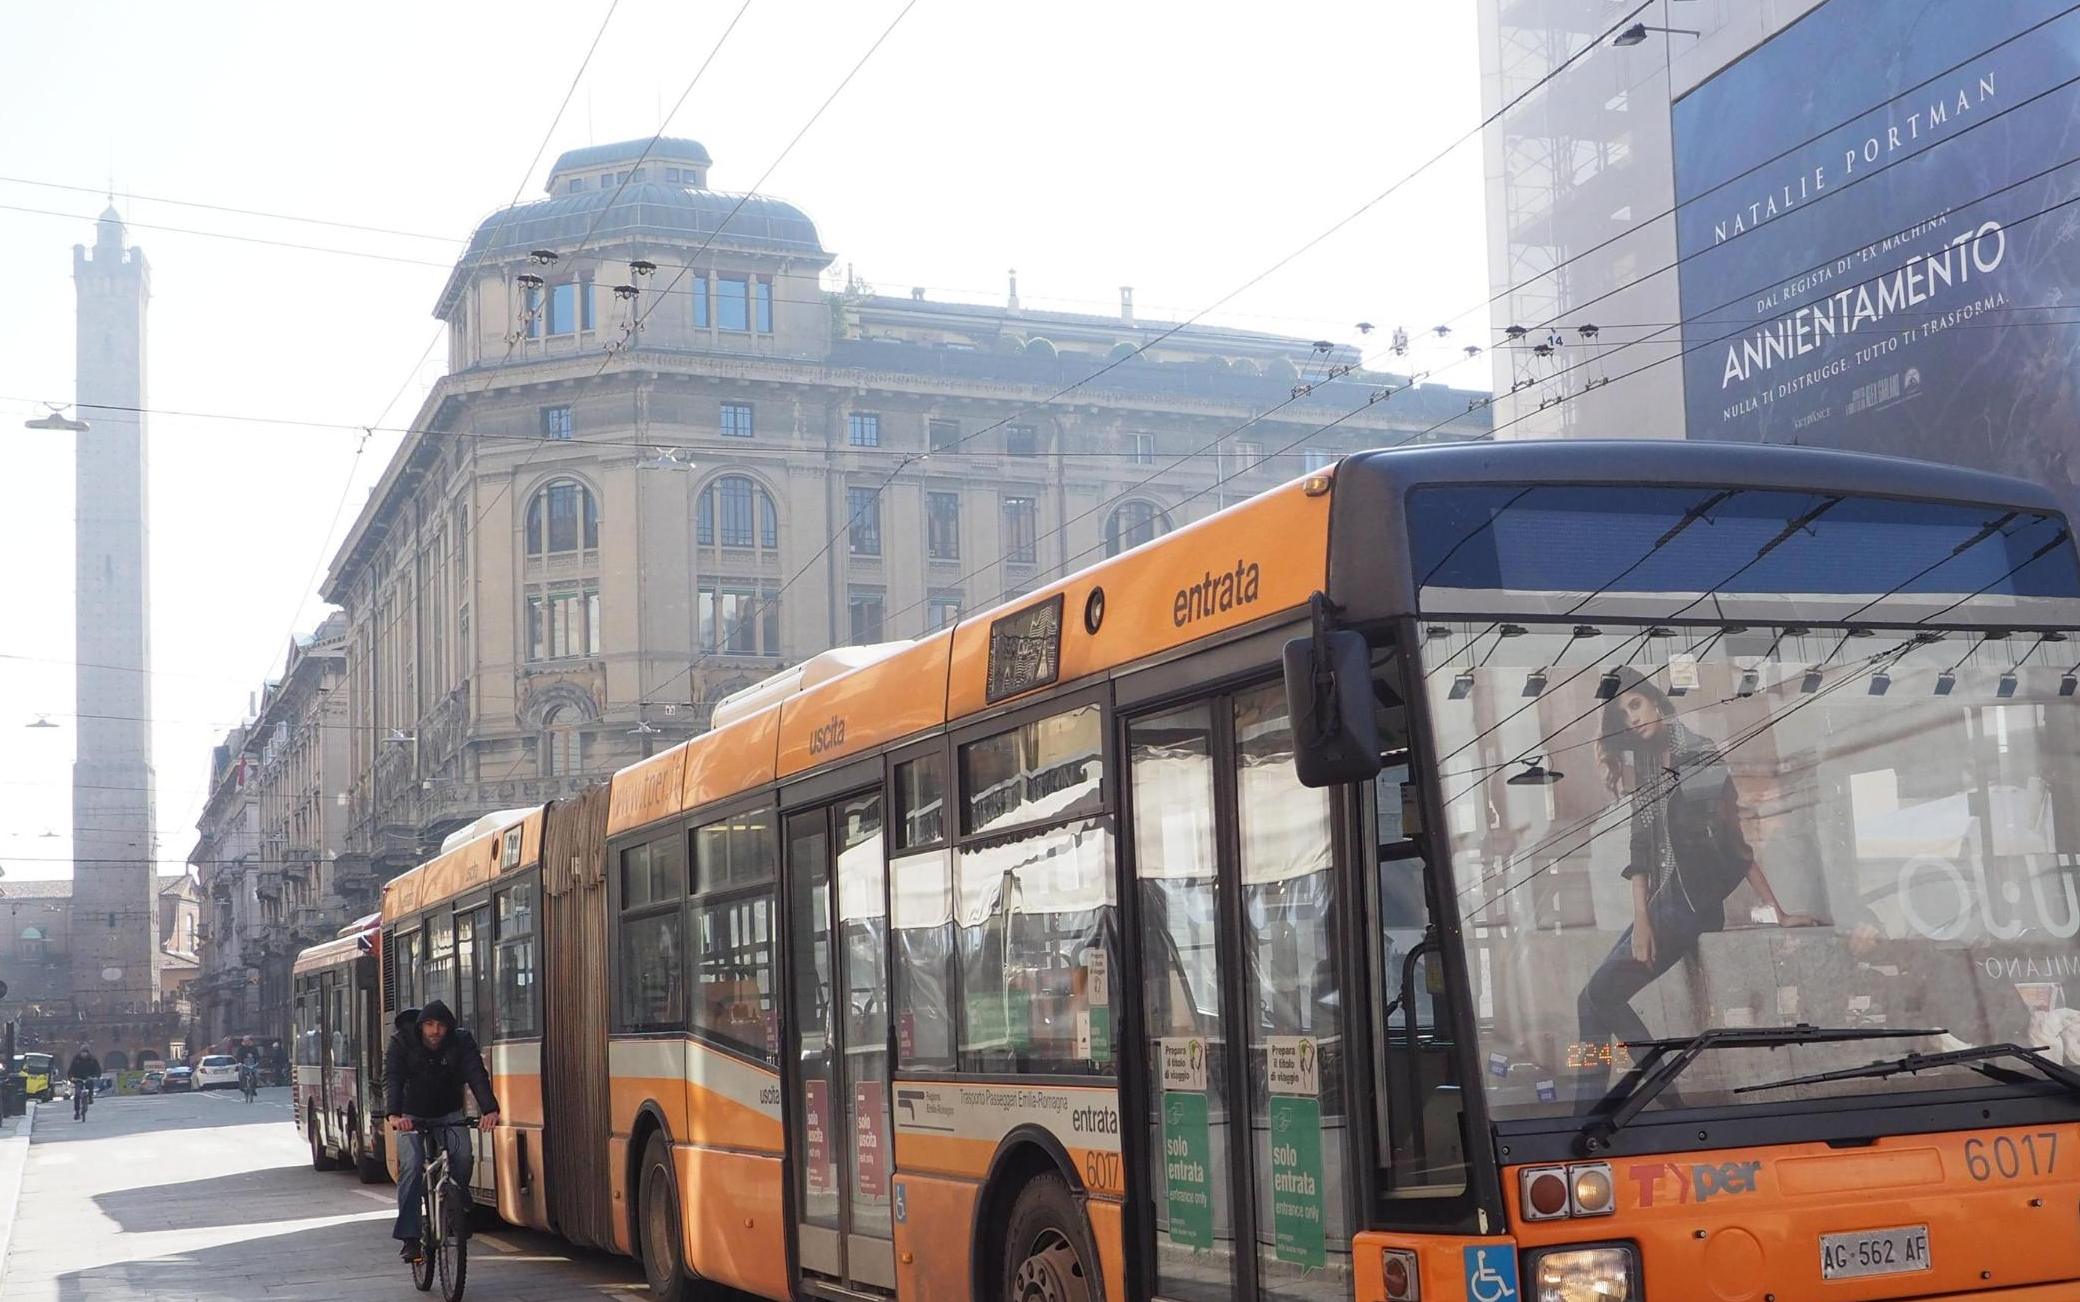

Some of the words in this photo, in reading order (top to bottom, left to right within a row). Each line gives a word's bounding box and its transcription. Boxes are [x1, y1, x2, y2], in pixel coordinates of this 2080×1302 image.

[1715, 166, 1825, 245] NATALIE
[1846, 72, 1995, 174] PORTMAN
[1722, 221, 2006, 389] ANNIENTAMENTO
[1757, 292, 1780, 314] DAL
[1783, 269, 1832, 300] REGISTA
[1838, 258, 1851, 274] DI
[1723, 399, 1758, 422] NULLA
[1762, 391, 1774, 406] TI
[1778, 360, 1850, 398] DISTRUGGE.
[1855, 337, 1898, 365] TUTTO
[1902, 329, 1916, 346] TI
[1921, 292, 2010, 337] TRASFORMA.
[1173, 559, 1260, 628] entrata
[809, 715, 845, 756] uscita
[1073, 1105, 1118, 1134] entrata
[1167, 1135, 1188, 1156] solo
[1273, 1143, 1297, 1167] solo
[1964, 1133, 2058, 1182] 6017
[1086, 1150, 1120, 1189] 6017
[1168, 1160, 1204, 1183] entrata
[1274, 1170, 1315, 1195] entrata
[1824, 1244, 1847, 1270] AG
[1859, 1239, 1895, 1265] 562
[1906, 1236, 1926, 1261] AF
